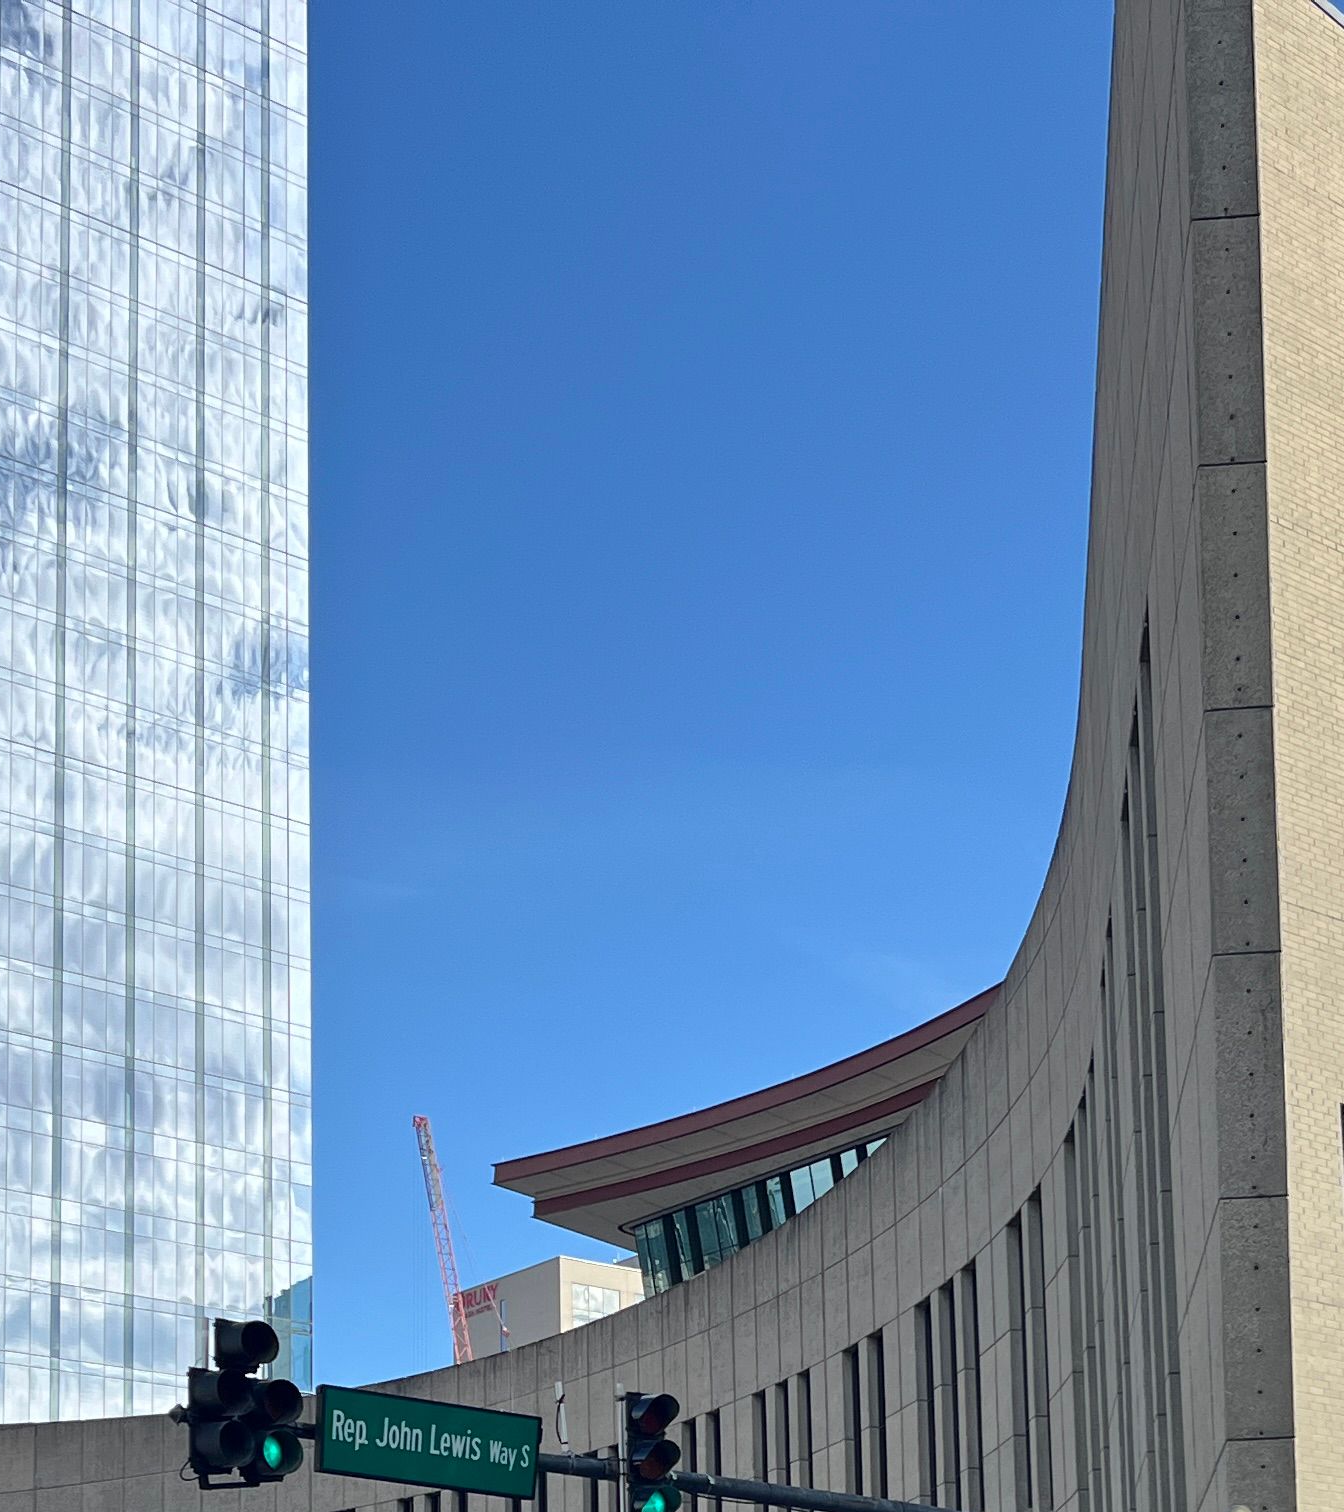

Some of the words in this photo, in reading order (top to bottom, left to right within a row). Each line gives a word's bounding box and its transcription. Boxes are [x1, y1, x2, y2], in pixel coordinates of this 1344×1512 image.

[331, 1409, 368, 1451] Rep.
[375, 1417, 422, 1452] John
[430, 1424, 482, 1462] Lewis
[489, 1439, 517, 1471] Way
[520, 1444, 530, 1468] S
